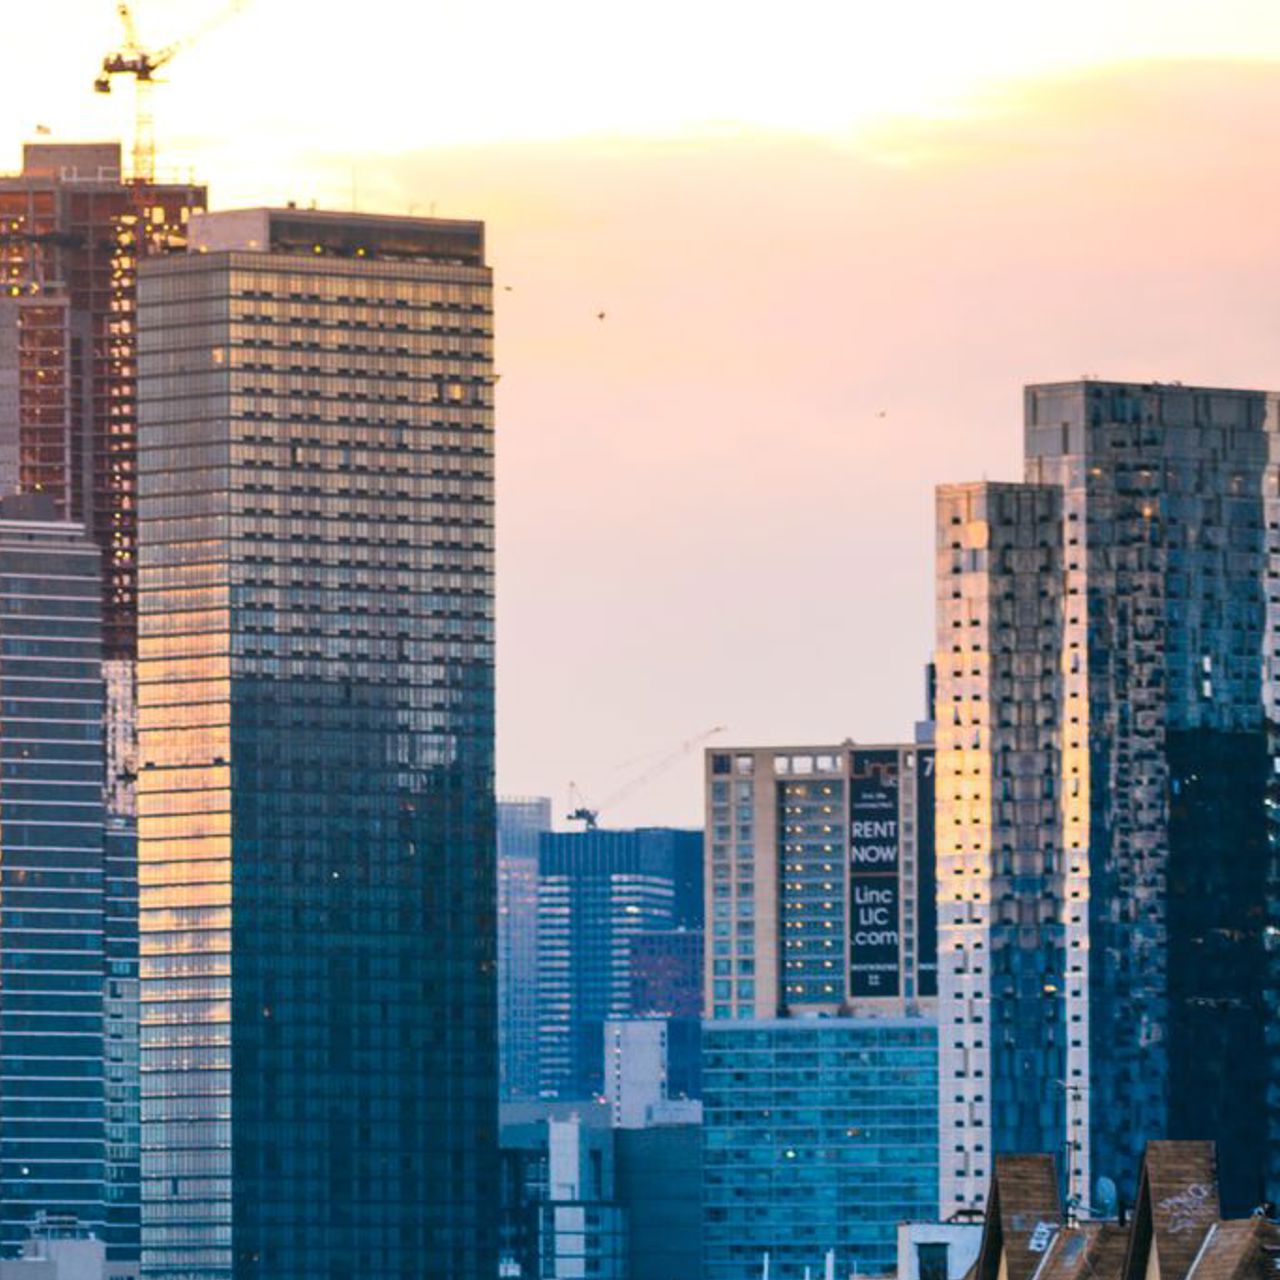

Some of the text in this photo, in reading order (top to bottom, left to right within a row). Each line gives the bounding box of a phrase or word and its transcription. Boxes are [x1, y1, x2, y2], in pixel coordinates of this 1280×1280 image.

[852, 822, 896, 838] RENT
[851, 846, 897, 862] NOW
[855, 886, 892, 904] Linc
[860, 907, 889, 925] LIC
